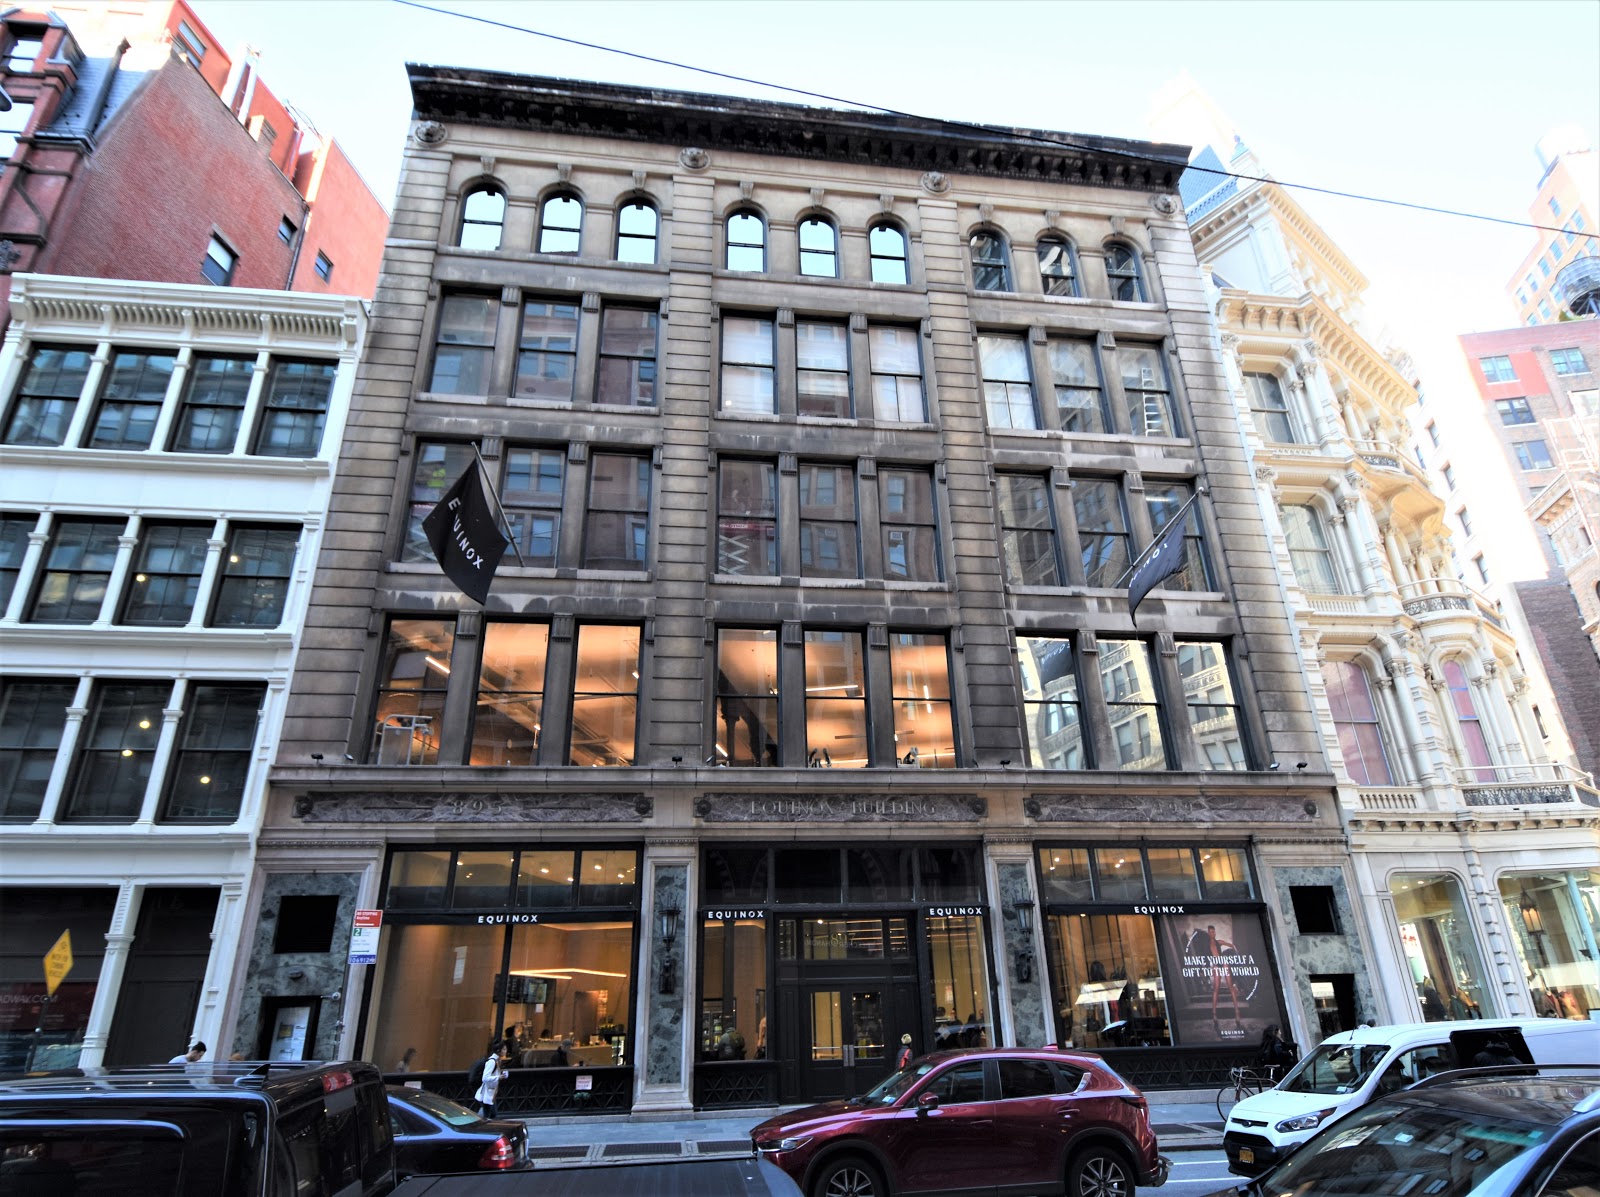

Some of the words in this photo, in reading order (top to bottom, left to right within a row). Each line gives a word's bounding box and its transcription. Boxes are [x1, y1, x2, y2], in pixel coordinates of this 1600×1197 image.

[448, 497, 484, 570] EUINOX
[453, 800, 501, 816] 895
[751, 800, 834, 815] EQUINOX
[852, 800, 935, 815] BUILDING
[708, 910, 764, 920] EQUINOX
[929, 907, 982, 916] EQUINOX
[1134, 905, 1184, 915] EQUINOX
[477, 914, 538, 925] EQUINOX
[1183, 956, 1206, 966] MAKE
[1207, 955, 1247, 965] YOURSELF
[1248, 955, 1254, 964] A
[1182, 968, 1201, 977] GIFT
[1202, 967, 1212, 977] TO
[1214, 967, 1230, 976] THE
[1230, 966, 1260, 976] WORLD
